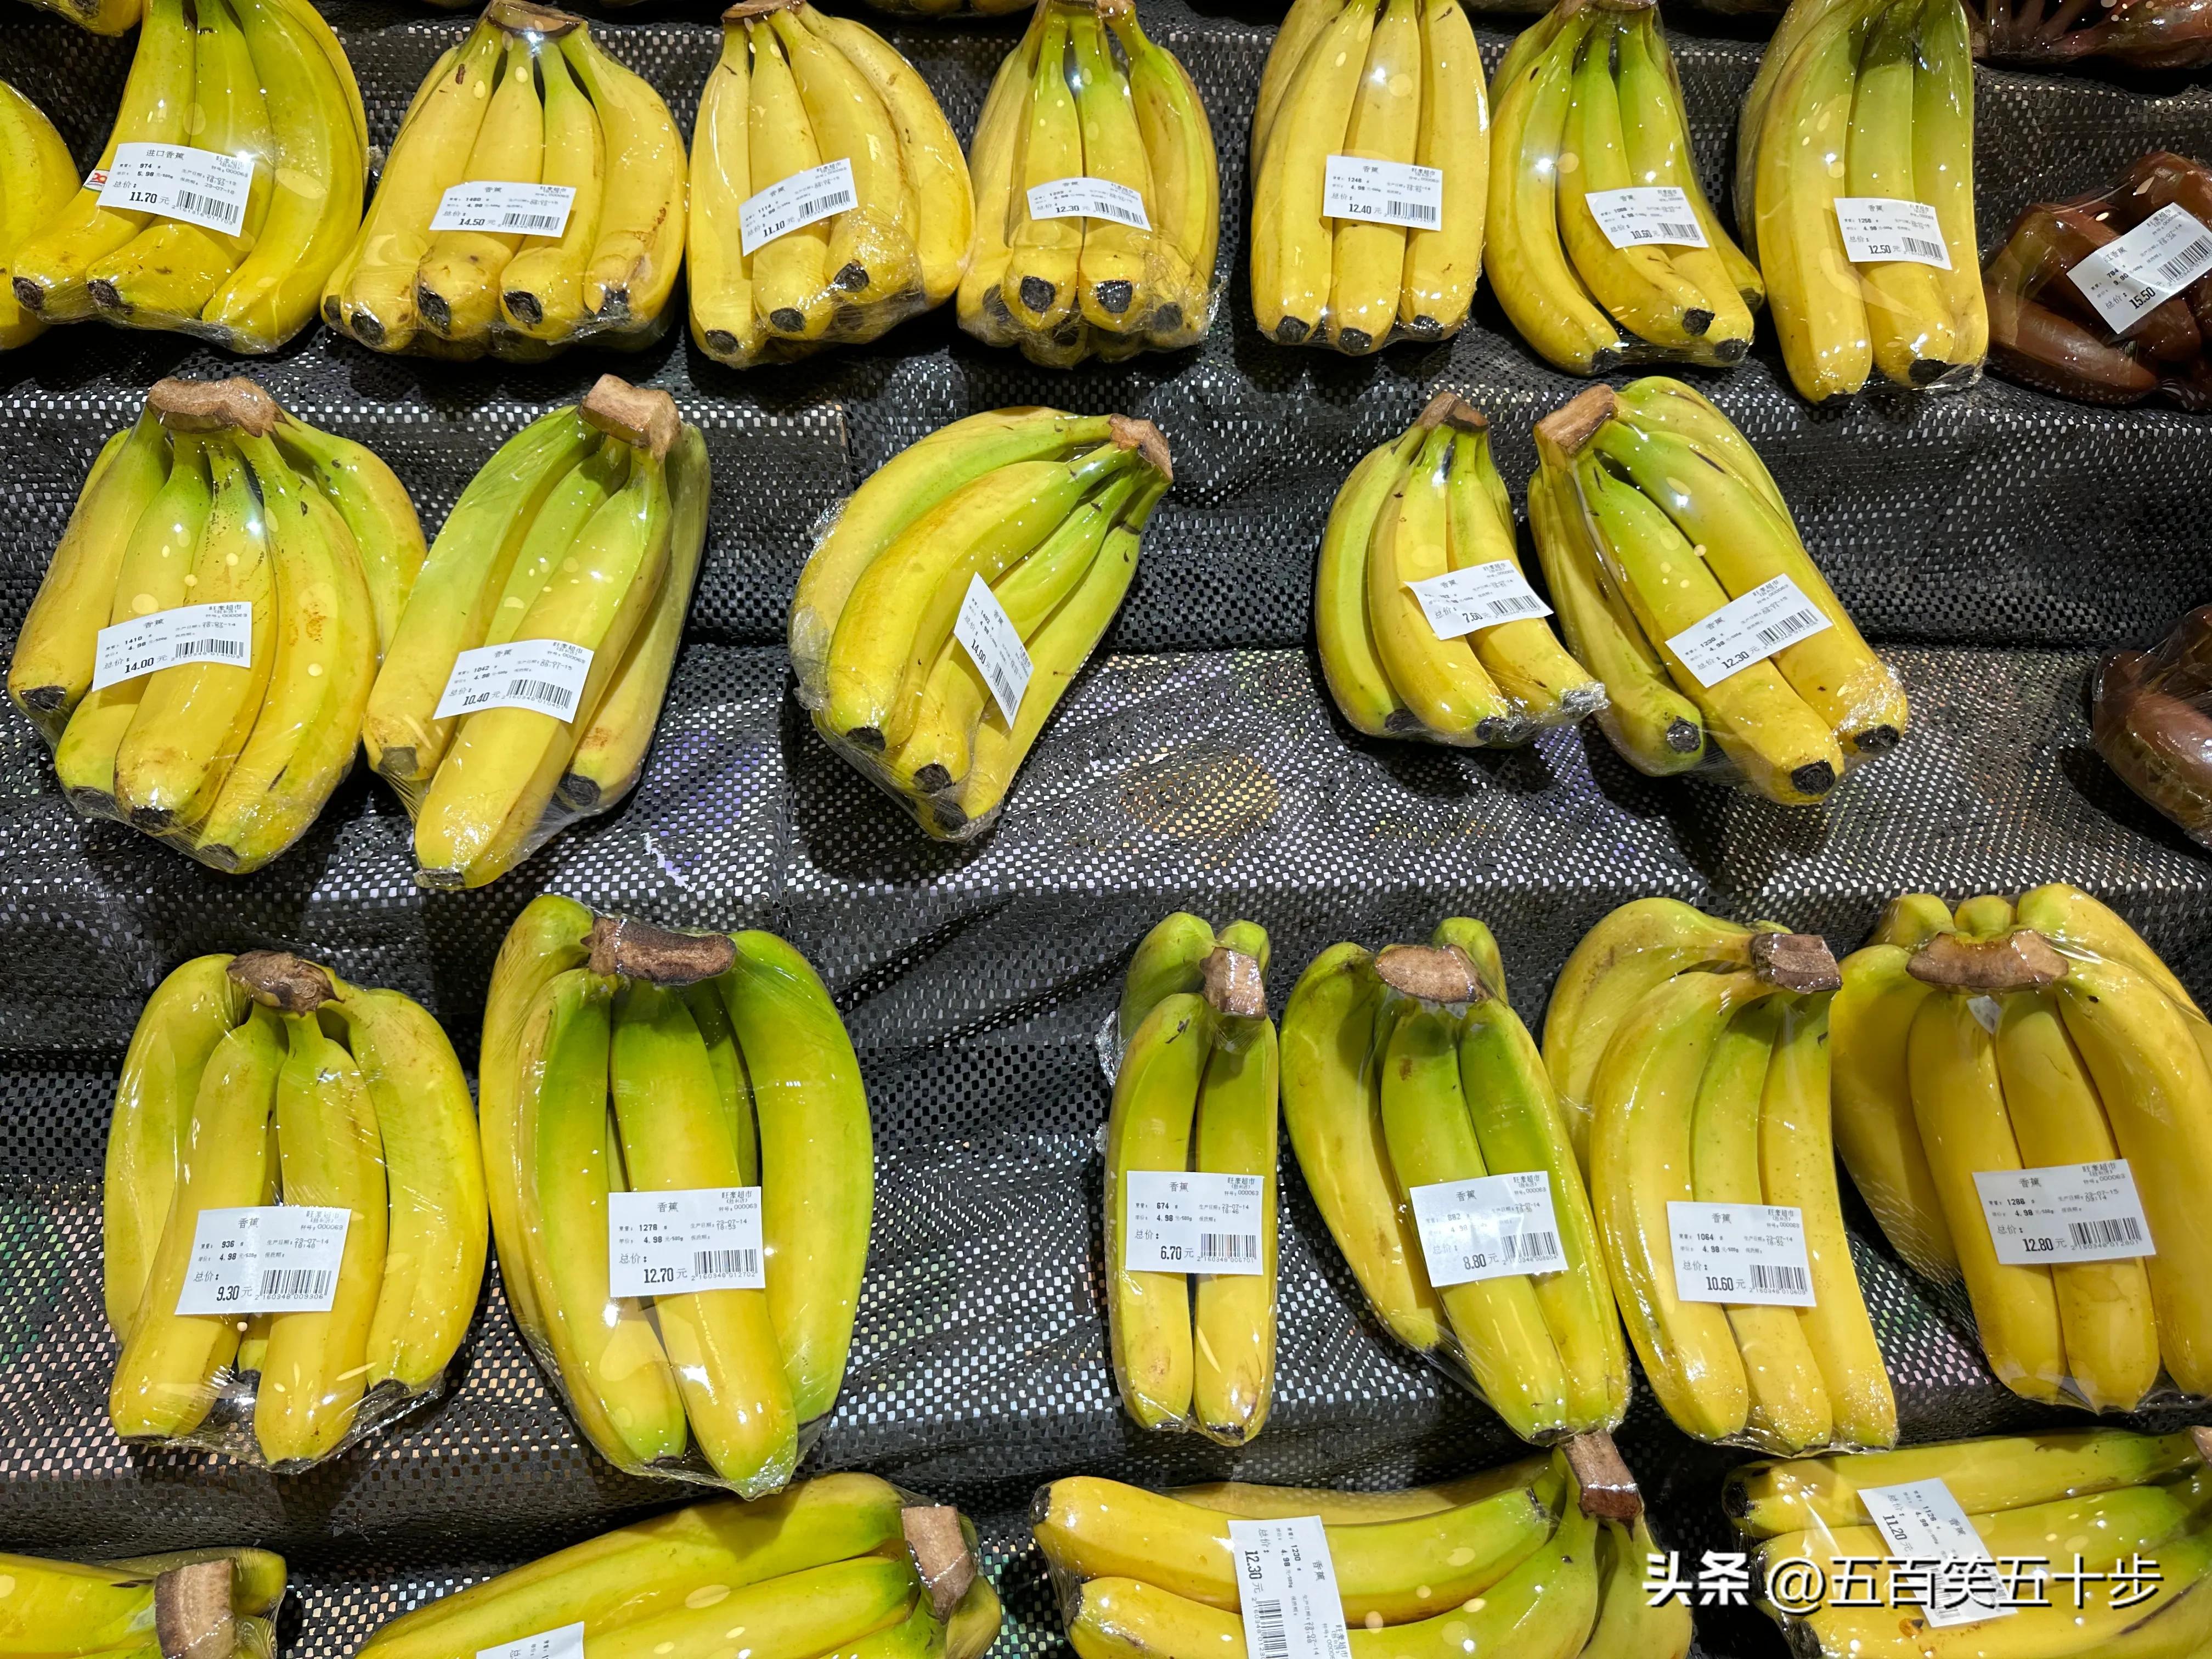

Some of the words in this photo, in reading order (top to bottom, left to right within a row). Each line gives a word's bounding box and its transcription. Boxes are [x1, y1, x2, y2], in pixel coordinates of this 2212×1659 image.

[129, 192, 157, 204] 11.70
[1056, 205, 1079, 213] 12.30
[1349, 204, 1372, 214] 12.40
[763, 221, 786, 238] 11.10
[1869, 245, 1891, 254] 12.50
[2129, 287, 2157, 310] 15.50
[1462, 613, 1483, 623] 7.60
[126, 636, 143, 645] 1410
[1700, 637, 1717, 648] 1230
[1708, 640, 1725, 651] 4.98
[970, 639, 987, 665] 14.00
[125, 658, 155, 674] 14.00
[1722, 651, 1750, 670] 12.30
[462, 691, 490, 706] 10.40
[1170, 1182, 1188, 1192] 香蕉
[2019, 1178, 2041, 1188] 香蕉
[1456, 1190, 1476, 1201] 香蕉
[658, 1202, 678, 1212] 香蕉
[238, 1218, 259, 1229] 香蕉
[1712, 1213, 1731, 1223] 香蕉
[1135, 1229, 1159, 1239] 总价：
[2023, 1238, 2053, 1251] 12.80
[2055, 1238, 2067, 1249] 元
[619, 1253, 647, 1264] 总价：
[1161, 1246, 1181, 1260] 6.70
[1184, 1248, 1194, 1258] 元
[1463, 1254, 1486, 1269] 8.80
[193, 1271, 219, 1282] 总价：
[644, 1268, 674, 1283] 12.70
[677, 1268, 687, 1279] 元
[1706, 1277, 1734, 1291] 10.60
[1736, 1279, 1746, 1289] 元
[217, 1285, 240, 1301] 9.30
[241, 1286, 252, 1297] 元
[1916, 1511, 1929, 1527] 4.98
[1922, 1506, 1937, 1522] 1126
[1882, 1514, 1907, 1541] 11.20
[1281, 1549, 1290, 1566] 4.98
[1291, 1545, 1301, 1561] 1230
[1245, 1550, 1262, 1579] 12.30
[1312, 1560, 1325, 1581] 香蕉
[1252, 1583, 1263, 1593] 元
